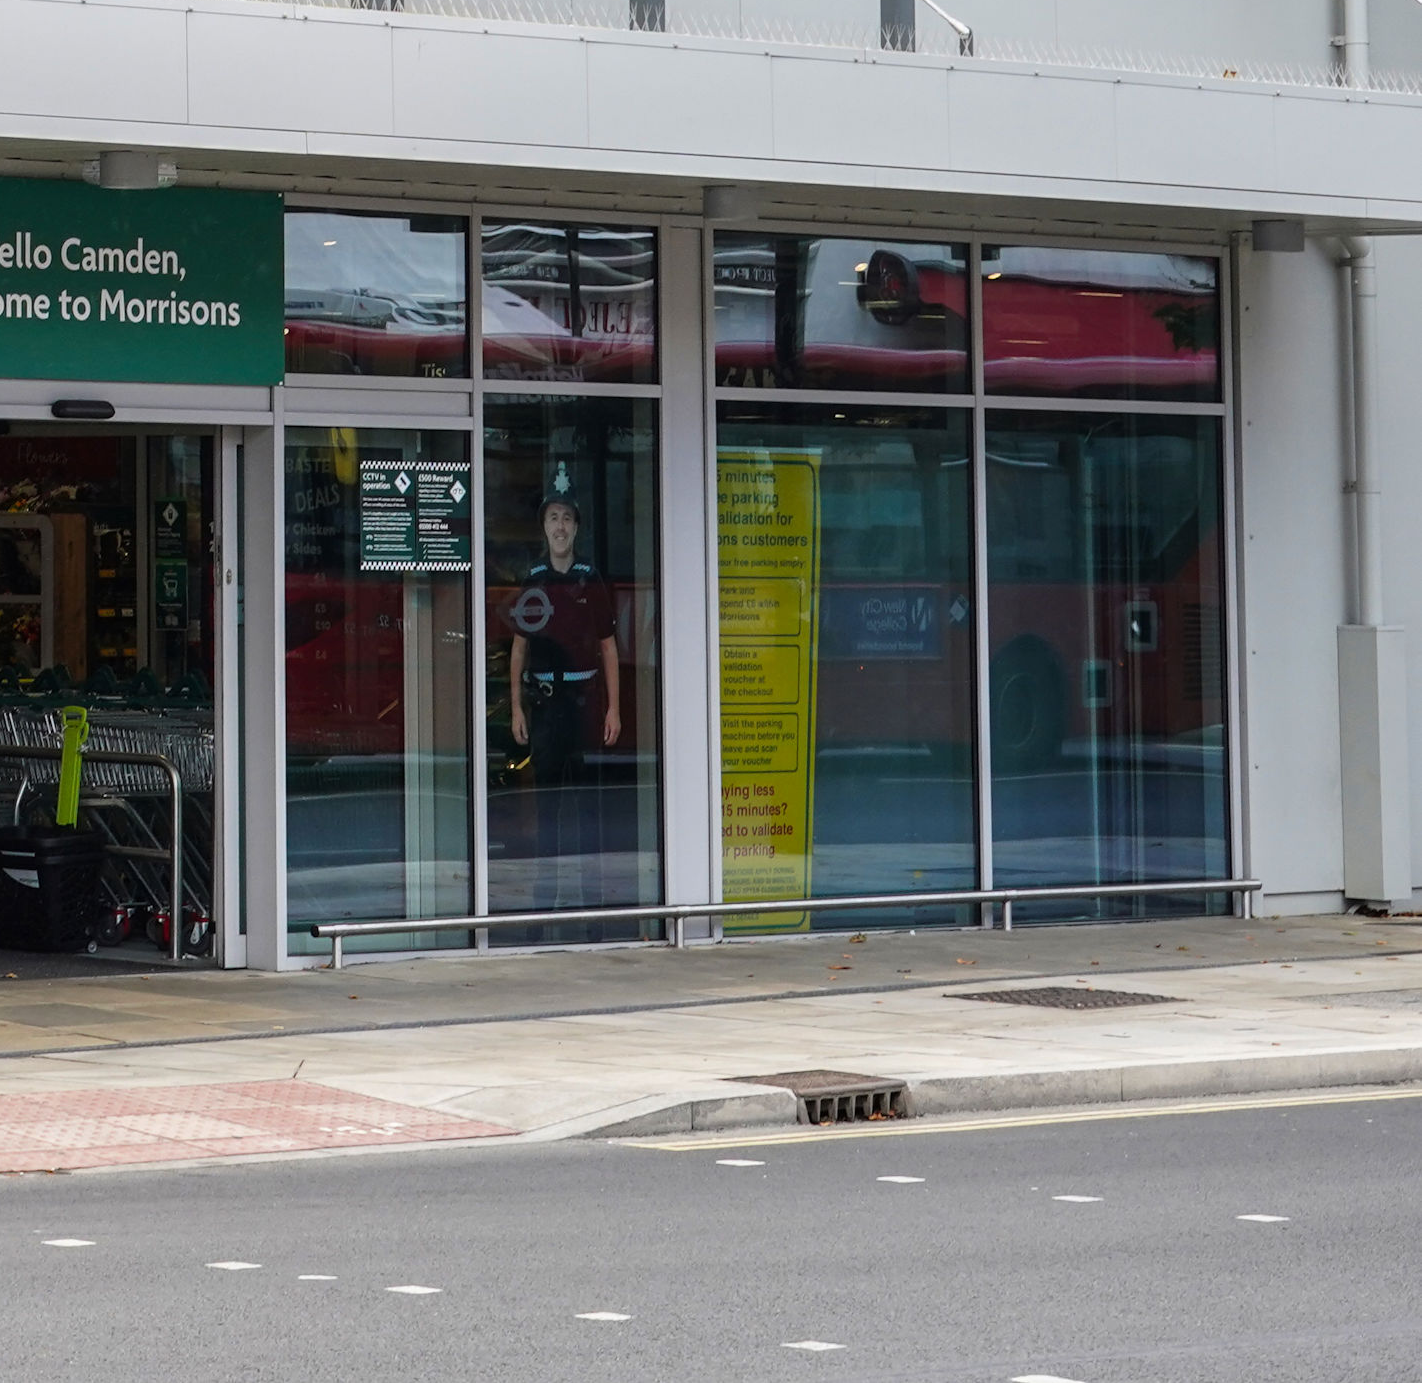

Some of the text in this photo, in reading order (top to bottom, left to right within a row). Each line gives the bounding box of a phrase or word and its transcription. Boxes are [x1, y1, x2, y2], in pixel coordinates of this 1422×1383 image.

[61, 237, 186, 281] Camden,
[59, 289, 91, 320] to
[100, 289, 241, 326] Morrisons
[363, 473, 379, 481] CCTV
[432, 475, 453, 483] Reward
[725, 470, 776, 483] minutes
[363, 482, 390, 491] operation
[295, 485, 340, 513] DEALS
[732, 492, 779, 508] parking
[718, 511, 793, 526] alidation for
[742, 533, 808, 547] customers
[751, 559, 778, 568] parking
[724, 649, 751, 658] Obtain
[724, 663, 763, 671] validation
[724, 675, 756, 684] voucher
[724, 688, 773, 696] the checkout
[722, 719, 783, 729] Visit the parking
[758, 732, 780, 740] before
[781, 733, 796, 742] you
[722, 745, 742, 753] leave
[722, 757, 772, 766] your voucher
[722, 784, 775, 800] ying less
[737, 802, 788, 817] minutes?
[737, 822, 794, 837] to validate
[734, 843, 775, 861] parking
